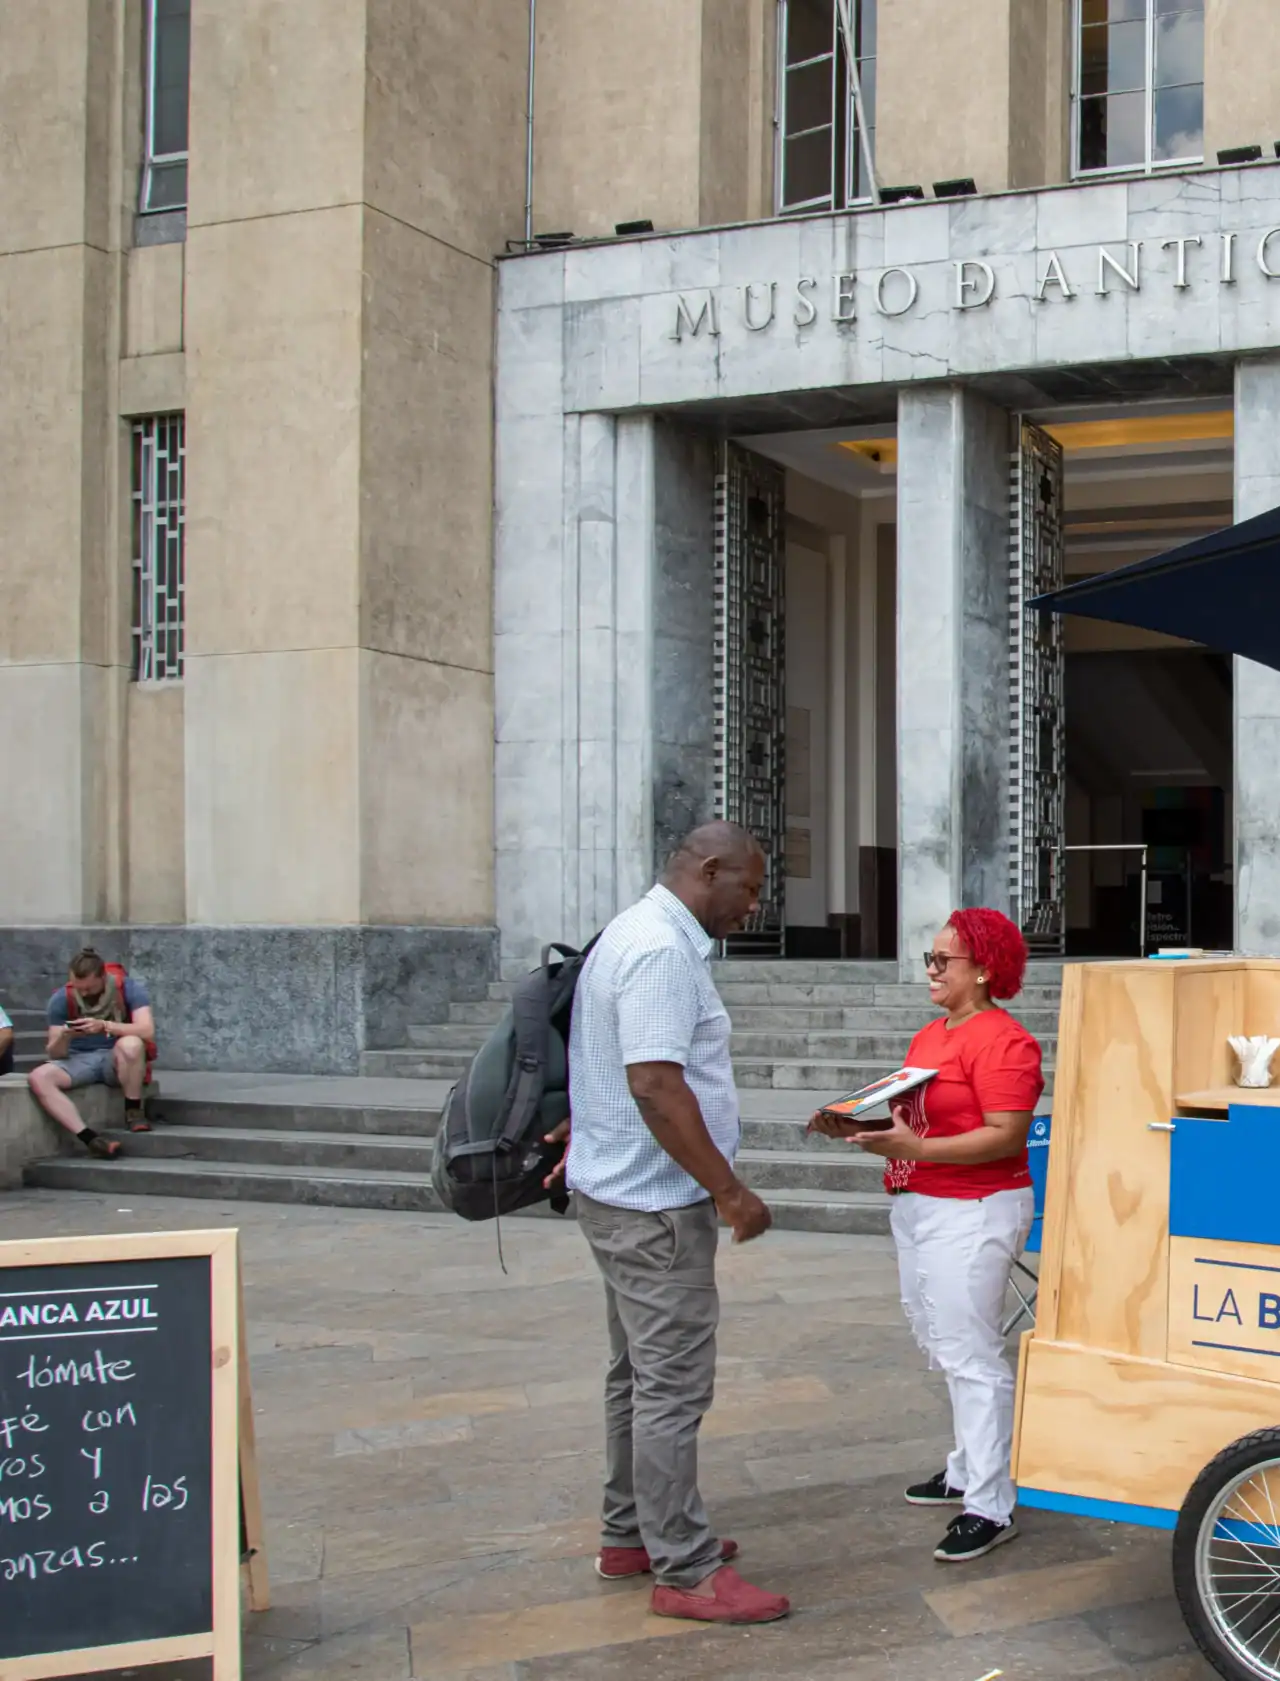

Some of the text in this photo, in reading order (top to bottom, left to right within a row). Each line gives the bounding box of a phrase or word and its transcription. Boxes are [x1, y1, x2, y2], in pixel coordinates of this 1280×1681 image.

[669, 268, 918, 342] MUSEO
[85, 1298, 158, 1322] AZUL
[1193, 1284, 1242, 1325] LA
[16, 1348, 137, 1389] tómate
[82, 1402, 137, 1432] con
[142, 1474, 187, 1512] las
